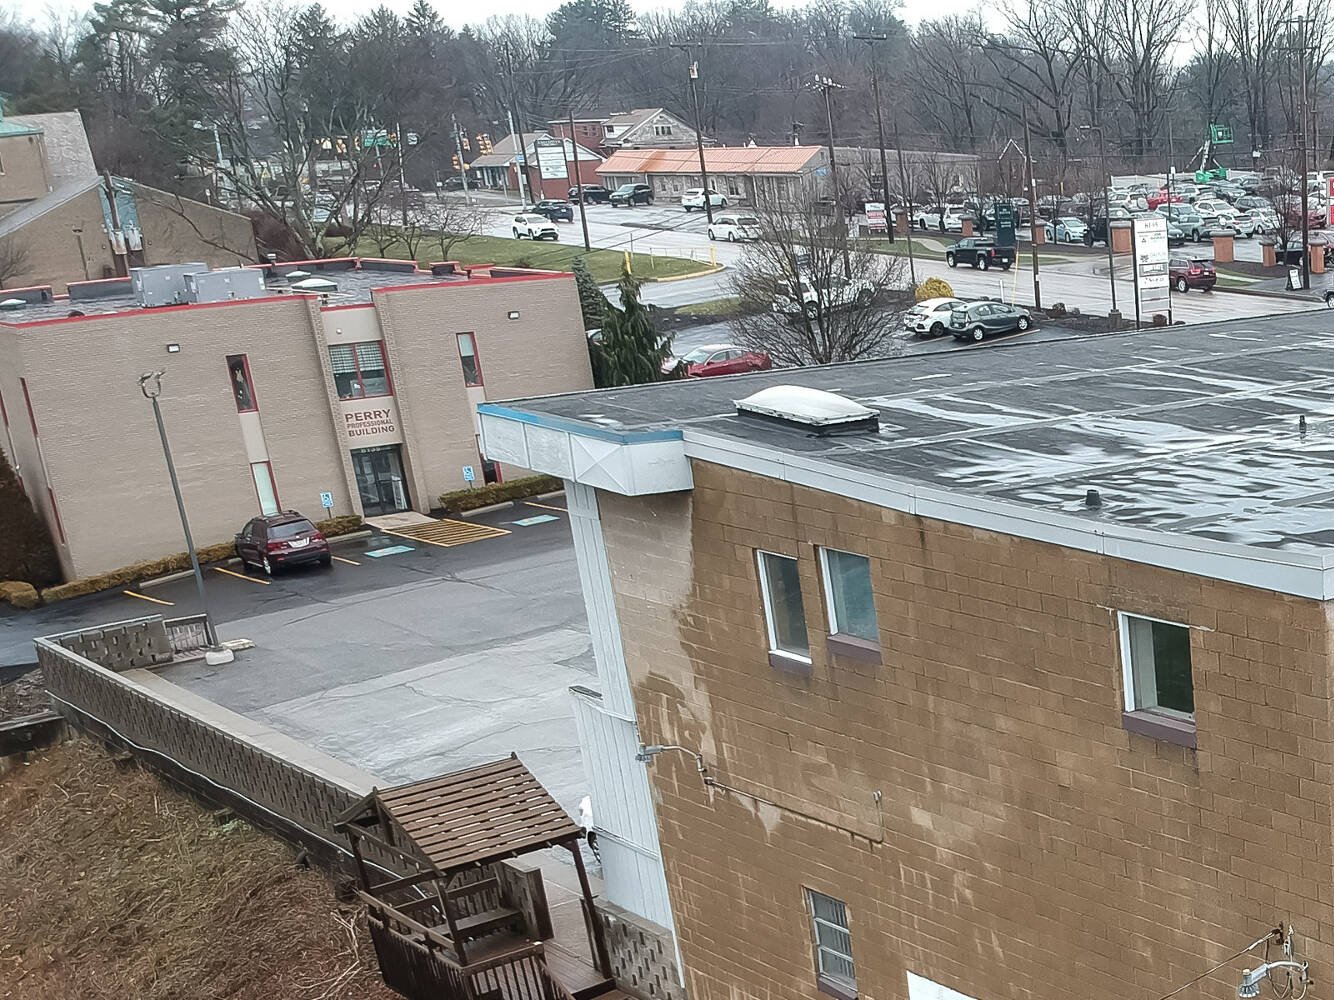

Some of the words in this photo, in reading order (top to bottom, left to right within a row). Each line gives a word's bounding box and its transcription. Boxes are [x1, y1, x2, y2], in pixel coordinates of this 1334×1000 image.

[345, 408, 391, 422] PERRY
[347, 419, 393, 429] PROFESSIONAL
[348, 425, 395, 437] BUILDING
